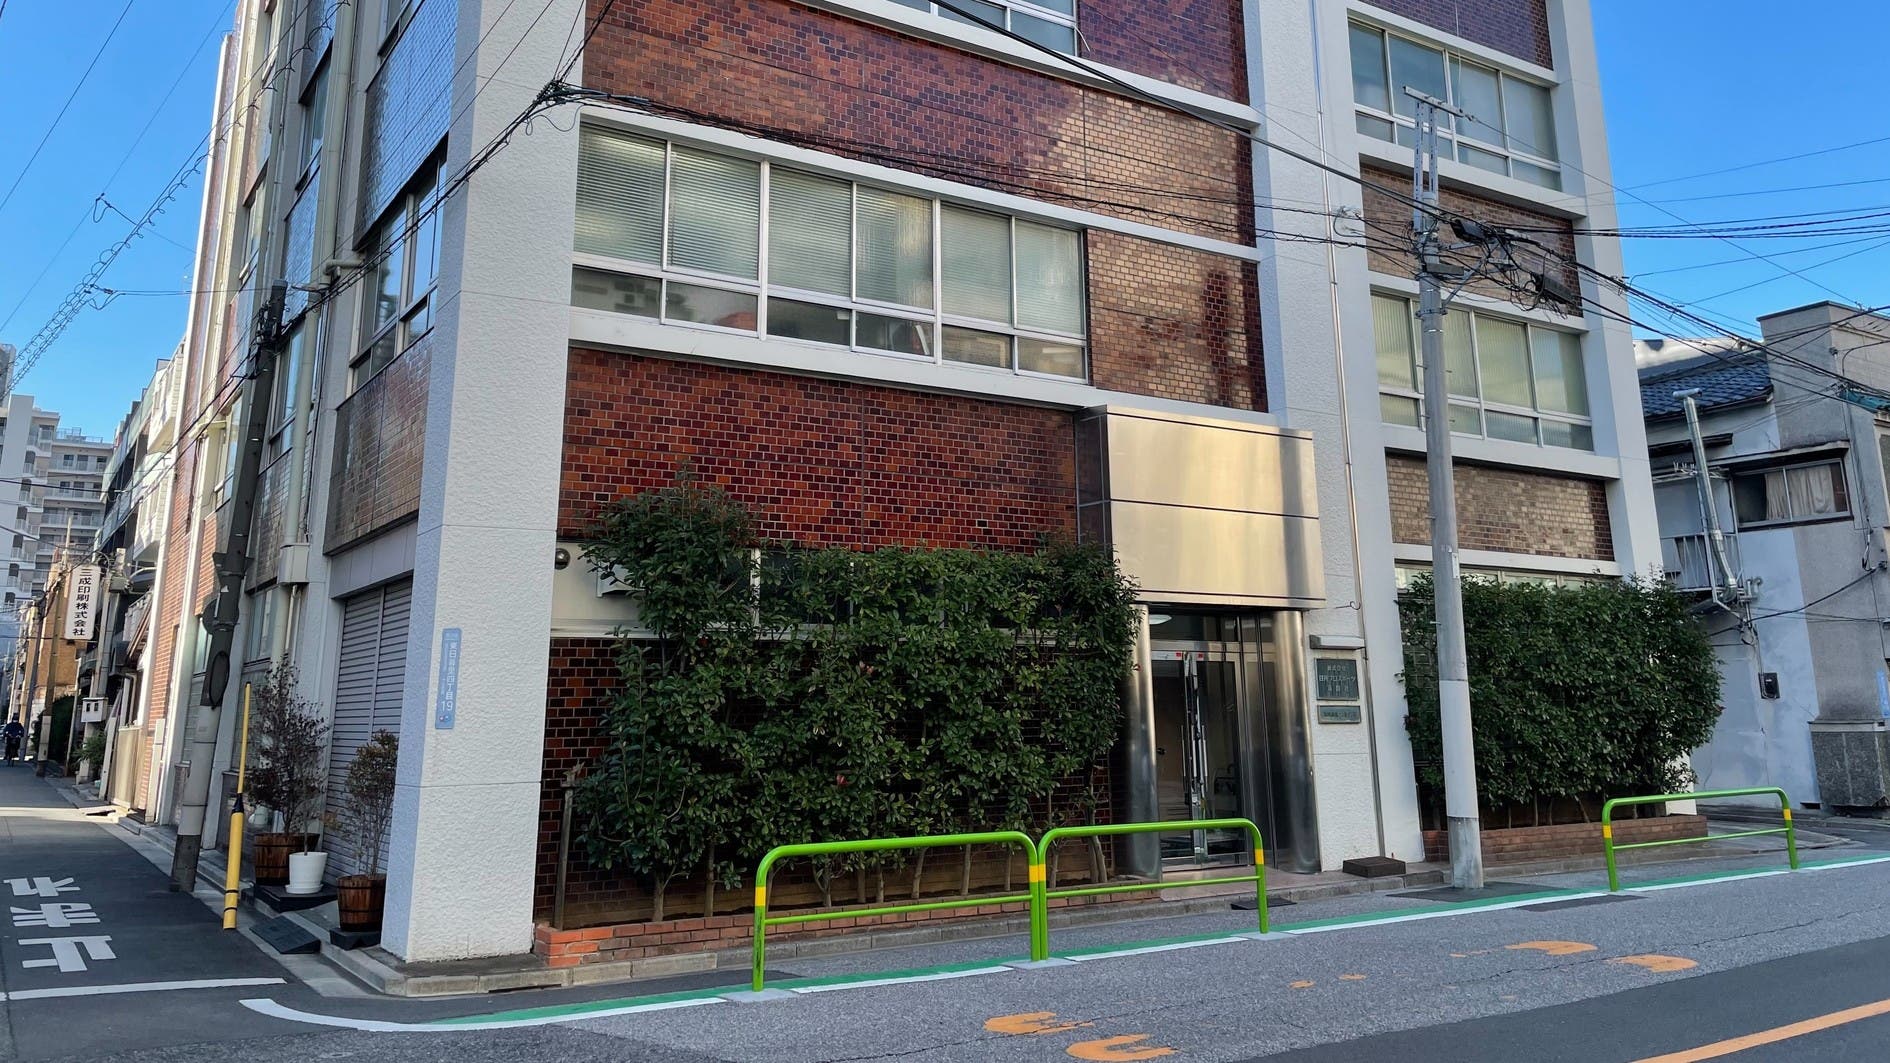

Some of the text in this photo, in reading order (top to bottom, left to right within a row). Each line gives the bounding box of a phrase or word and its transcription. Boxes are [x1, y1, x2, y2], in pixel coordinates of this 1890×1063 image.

[72, 568, 93, 636] 三成印刷株式会社
[441, 700, 454, 712] 19
[3, 877, 117, 973] 止まれ
